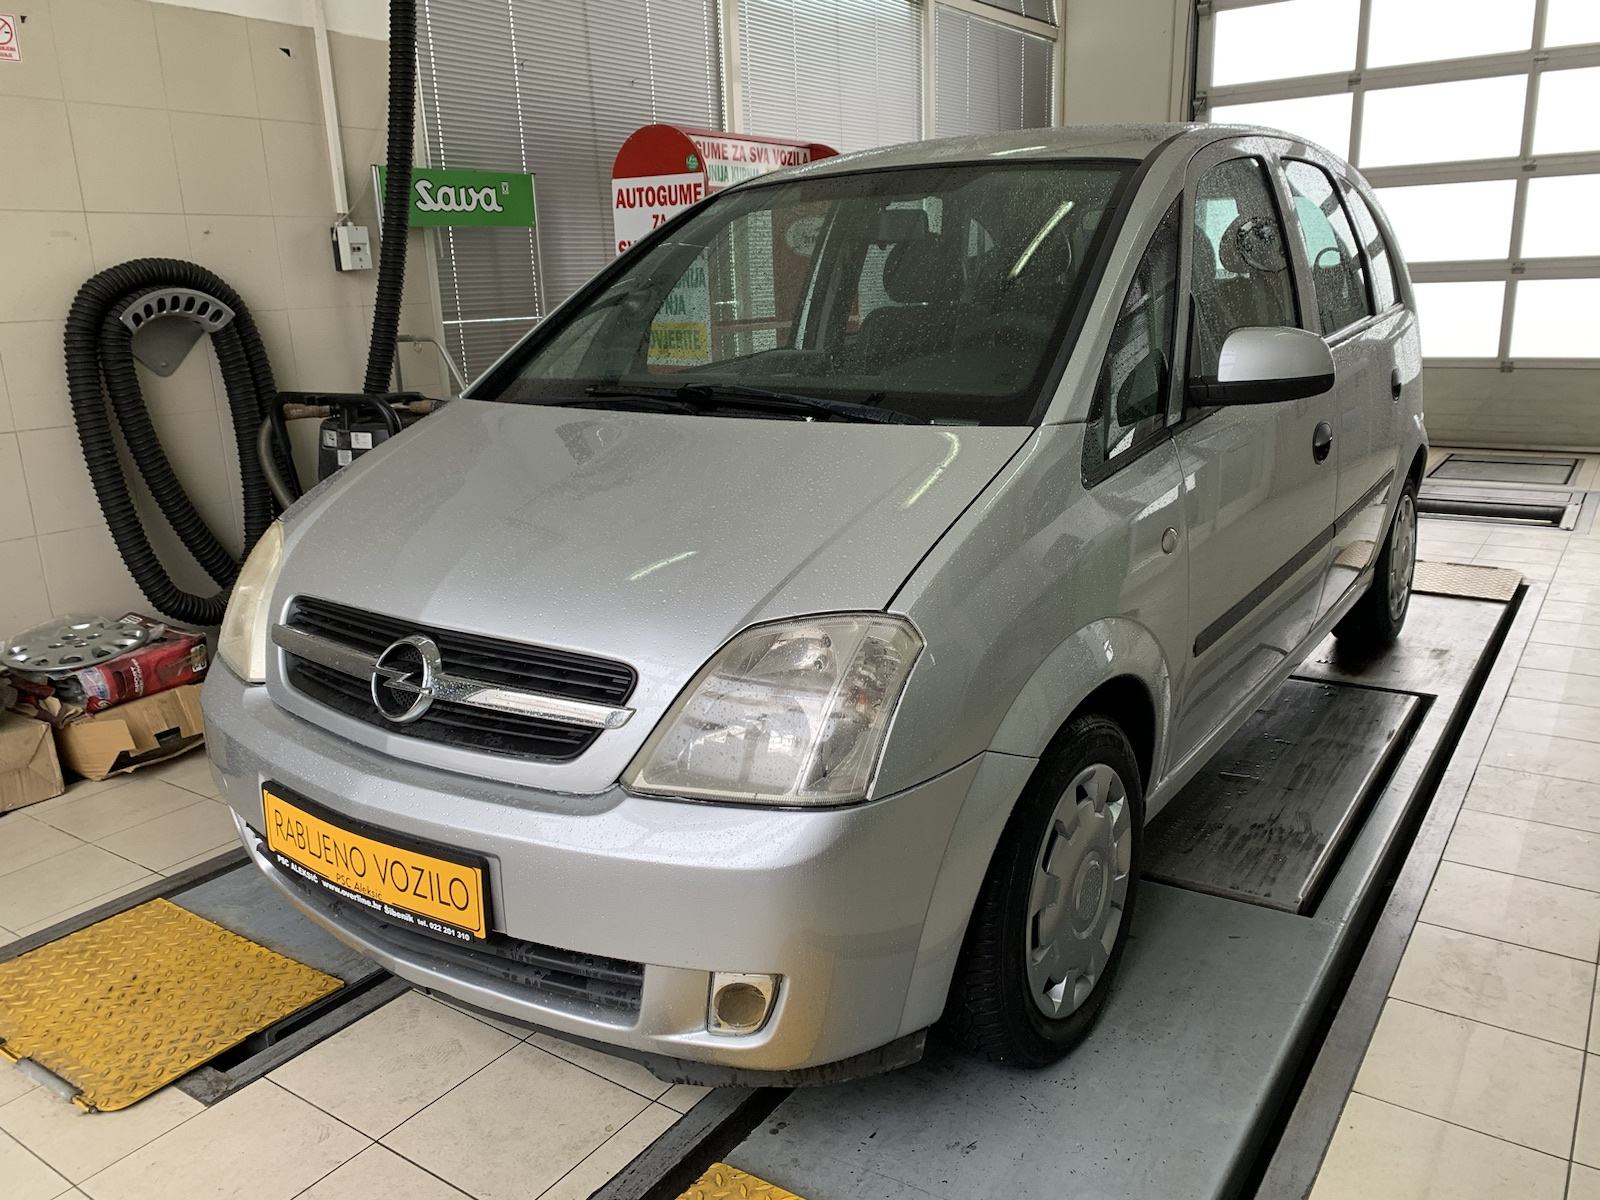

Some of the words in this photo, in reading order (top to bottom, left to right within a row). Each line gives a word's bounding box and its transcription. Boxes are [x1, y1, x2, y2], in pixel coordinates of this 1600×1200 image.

[731, 144, 747, 162] ZA
[749, 146, 770, 165] SVA
[772, 148, 809, 166] VOZILA
[414, 179, 504, 212] Sava
[616, 182, 702, 209] AUTOGUME
[274, 808, 367, 878] RABLJENO
[373, 853, 469, 912] VOZILO
[336, 873, 351, 889] PSC
[276, 854, 290, 867] PSC
[429, 922, 443, 932] 022
[443, 926, 456, 936] 201
[456, 931, 471, 941] 310
